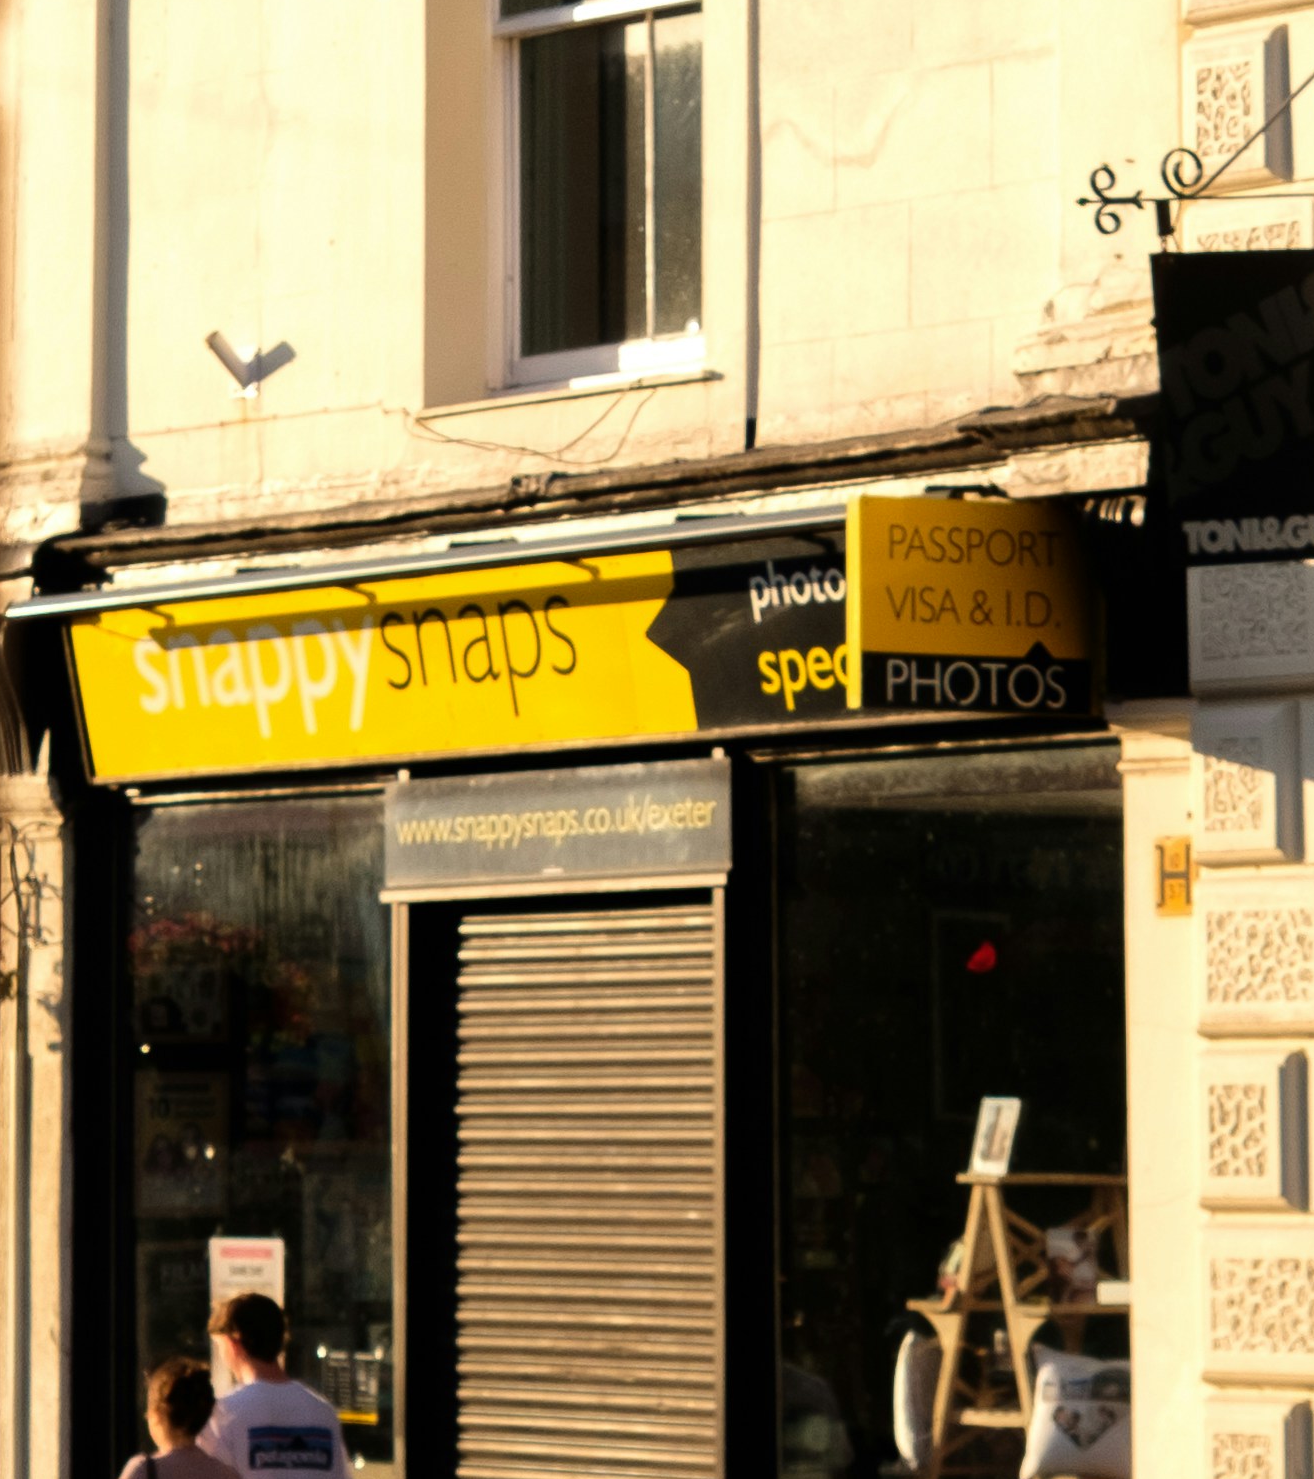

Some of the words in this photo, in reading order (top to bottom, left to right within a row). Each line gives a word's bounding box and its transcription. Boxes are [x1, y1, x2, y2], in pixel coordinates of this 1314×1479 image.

[888, 524, 1061, 568] PASSPORT
[886, 585, 961, 624] VISA
[969, 590, 993, 626] &
[1005, 590, 1062, 629] I.D.
[886, 658, 1067, 710] PHOTOS
[396, 794, 717, 851] www.snappysnaps.co.uk/exeter
